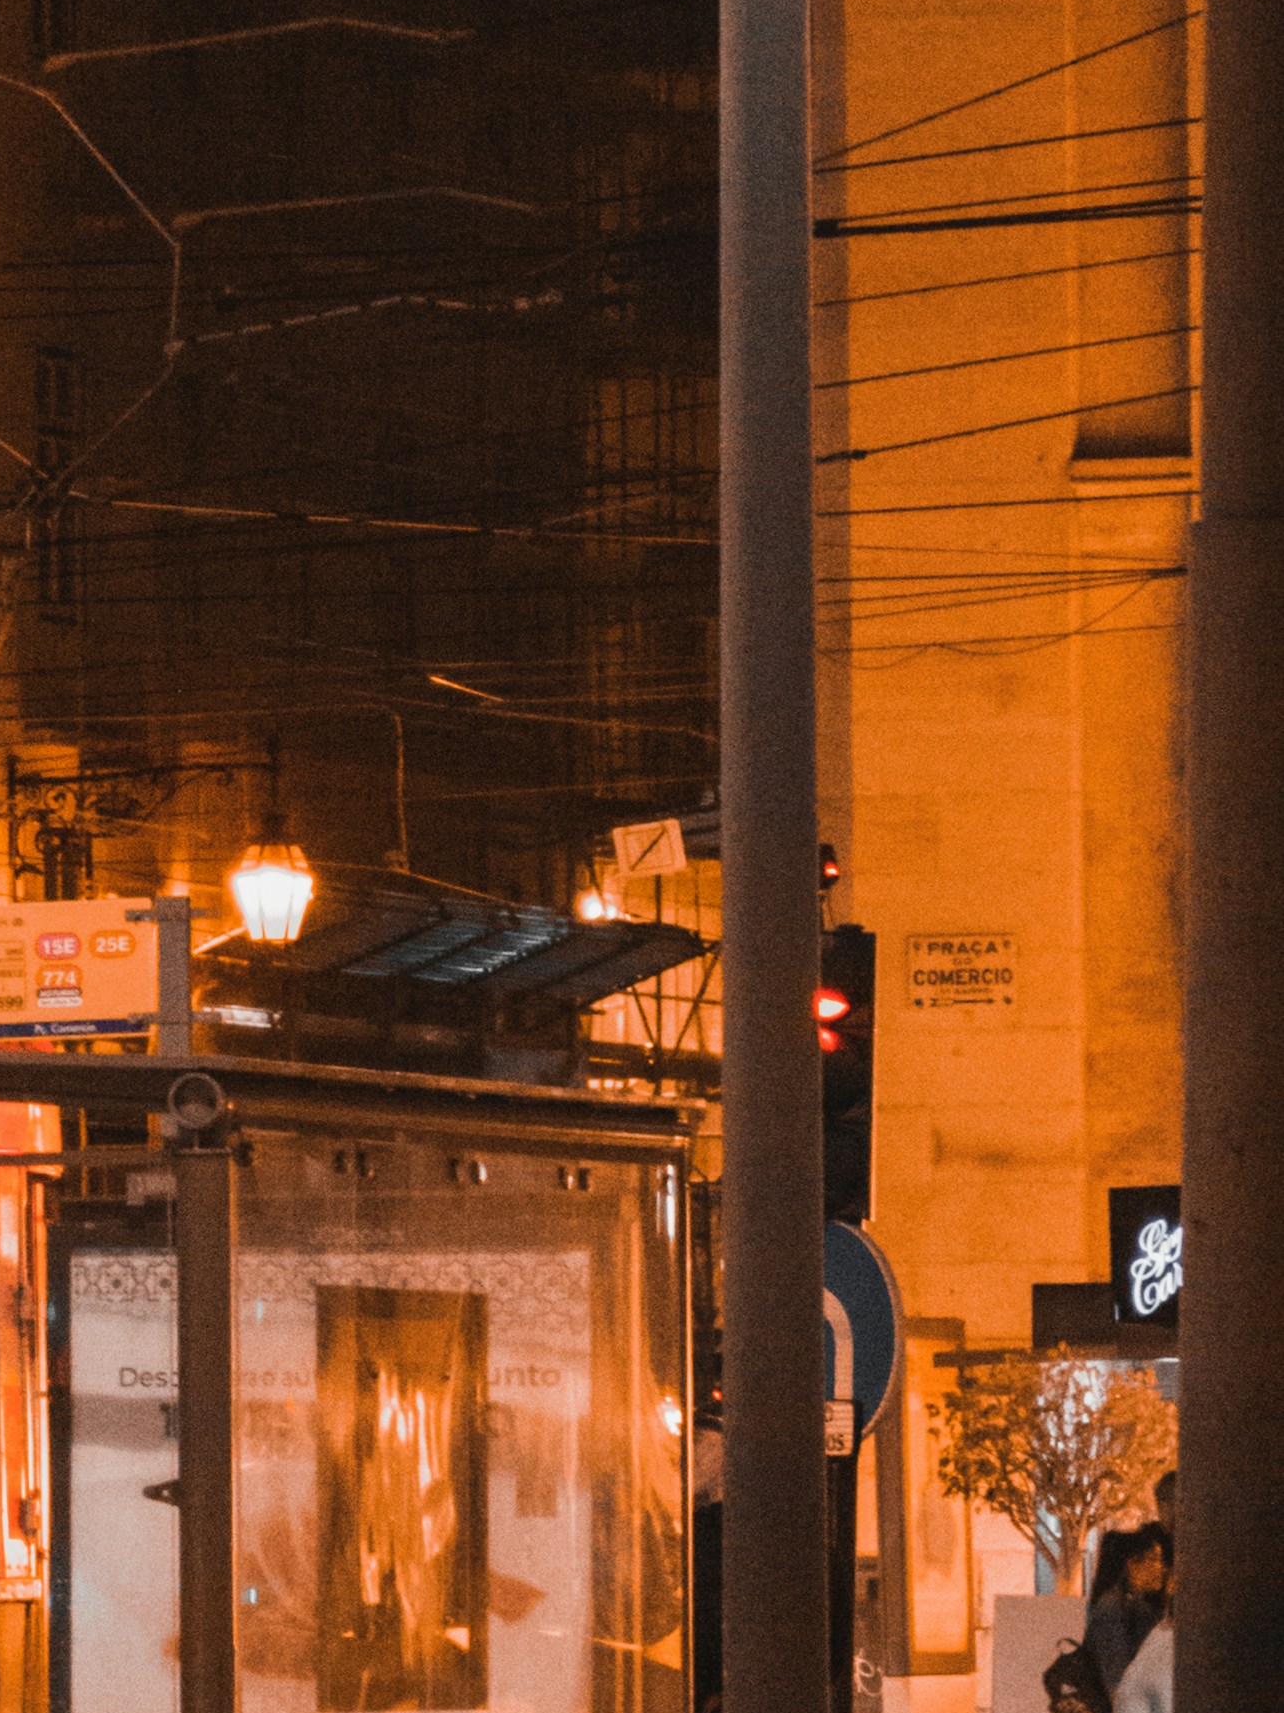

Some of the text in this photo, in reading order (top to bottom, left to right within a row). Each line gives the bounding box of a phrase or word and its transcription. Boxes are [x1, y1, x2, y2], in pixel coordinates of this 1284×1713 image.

[41, 938, 76, 955] 15E
[95, 935, 130, 953] 25E
[927, 940, 998, 956] PRAÇA
[42, 970, 77, 986] 774
